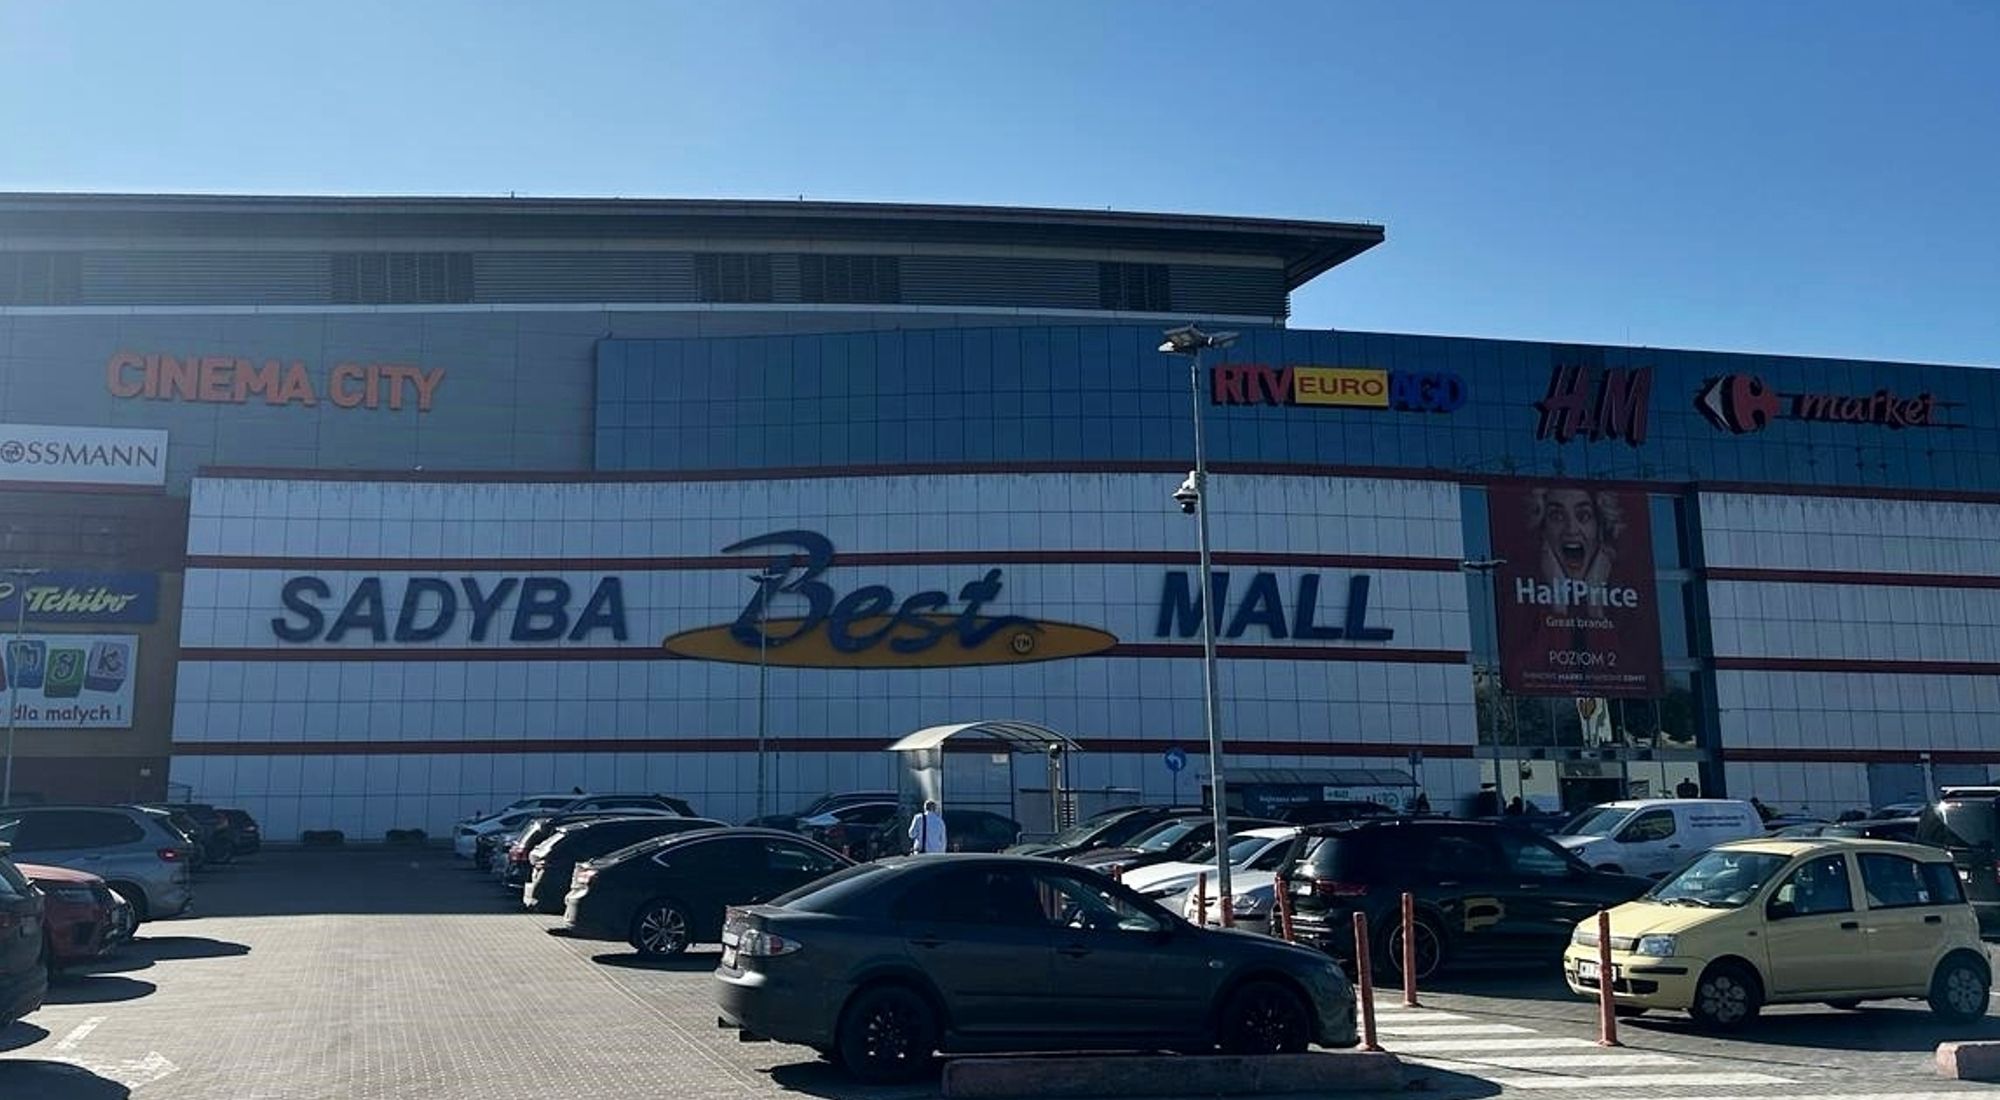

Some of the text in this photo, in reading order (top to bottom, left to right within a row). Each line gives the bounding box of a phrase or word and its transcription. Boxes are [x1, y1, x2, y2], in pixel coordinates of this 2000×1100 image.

[108, 353, 446, 412] CINEMA CITY
[1211, 364, 1467, 412] RTV EURO AGD
[1540, 361, 1650, 444] H&M
[1797, 391, 1938, 428] market
[25, 586, 140, 613] Tchibo
[271, 530, 1394, 654] SADYBA Best MALL
[1515, 577, 1638, 608] HalfPrice
[1545, 615, 1575, 629] Great
[1549, 651, 1617, 667] POZIOM 2
